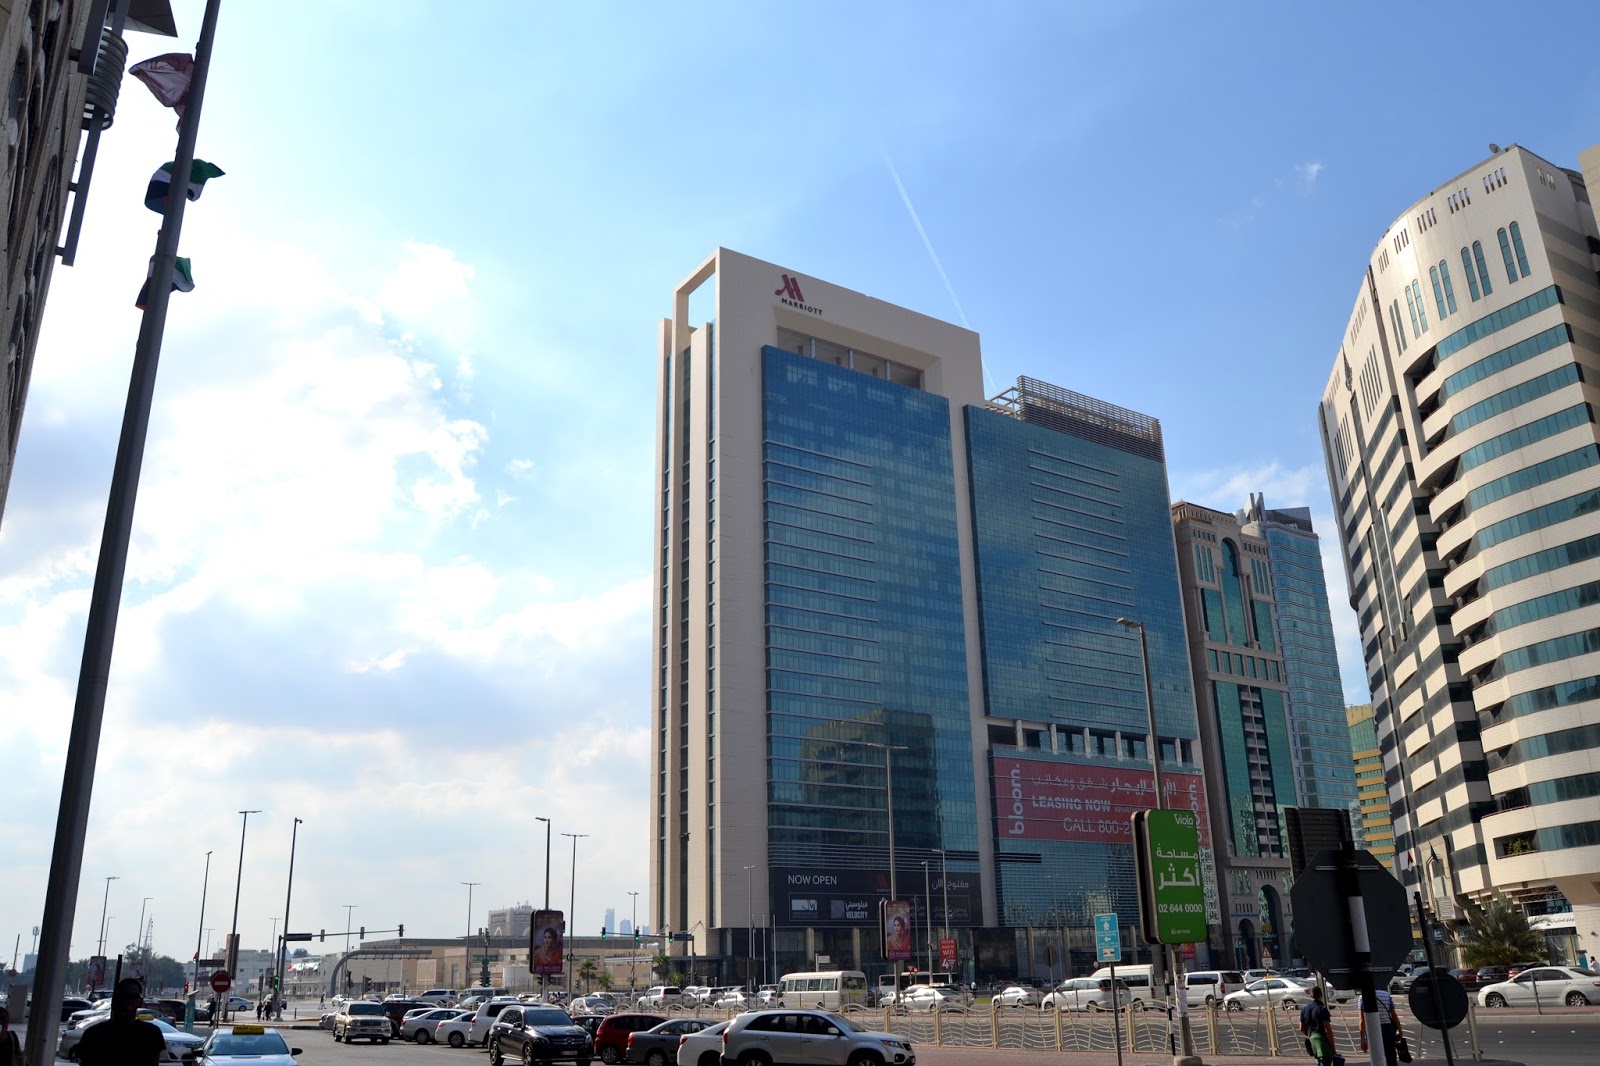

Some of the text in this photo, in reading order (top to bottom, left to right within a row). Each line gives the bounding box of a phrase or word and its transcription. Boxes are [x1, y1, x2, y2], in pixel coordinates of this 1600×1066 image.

[781, 297, 823, 316] MARRIOTT
[1032, 795, 1082, 811] LEASING
[1085, 799, 1111, 812] NOW
[1063, 817, 1097, 833] CALL
[1173, 813, 1194, 826] Viola
[787, 874, 838, 885] NOW OPEN
[1158, 862, 1201, 890] أكثر
[946, 880, 969, 891] مفتوح
[845, 910, 869, 919] VELOCITY
[1158, 903, 1203, 913] 02 644 0000
